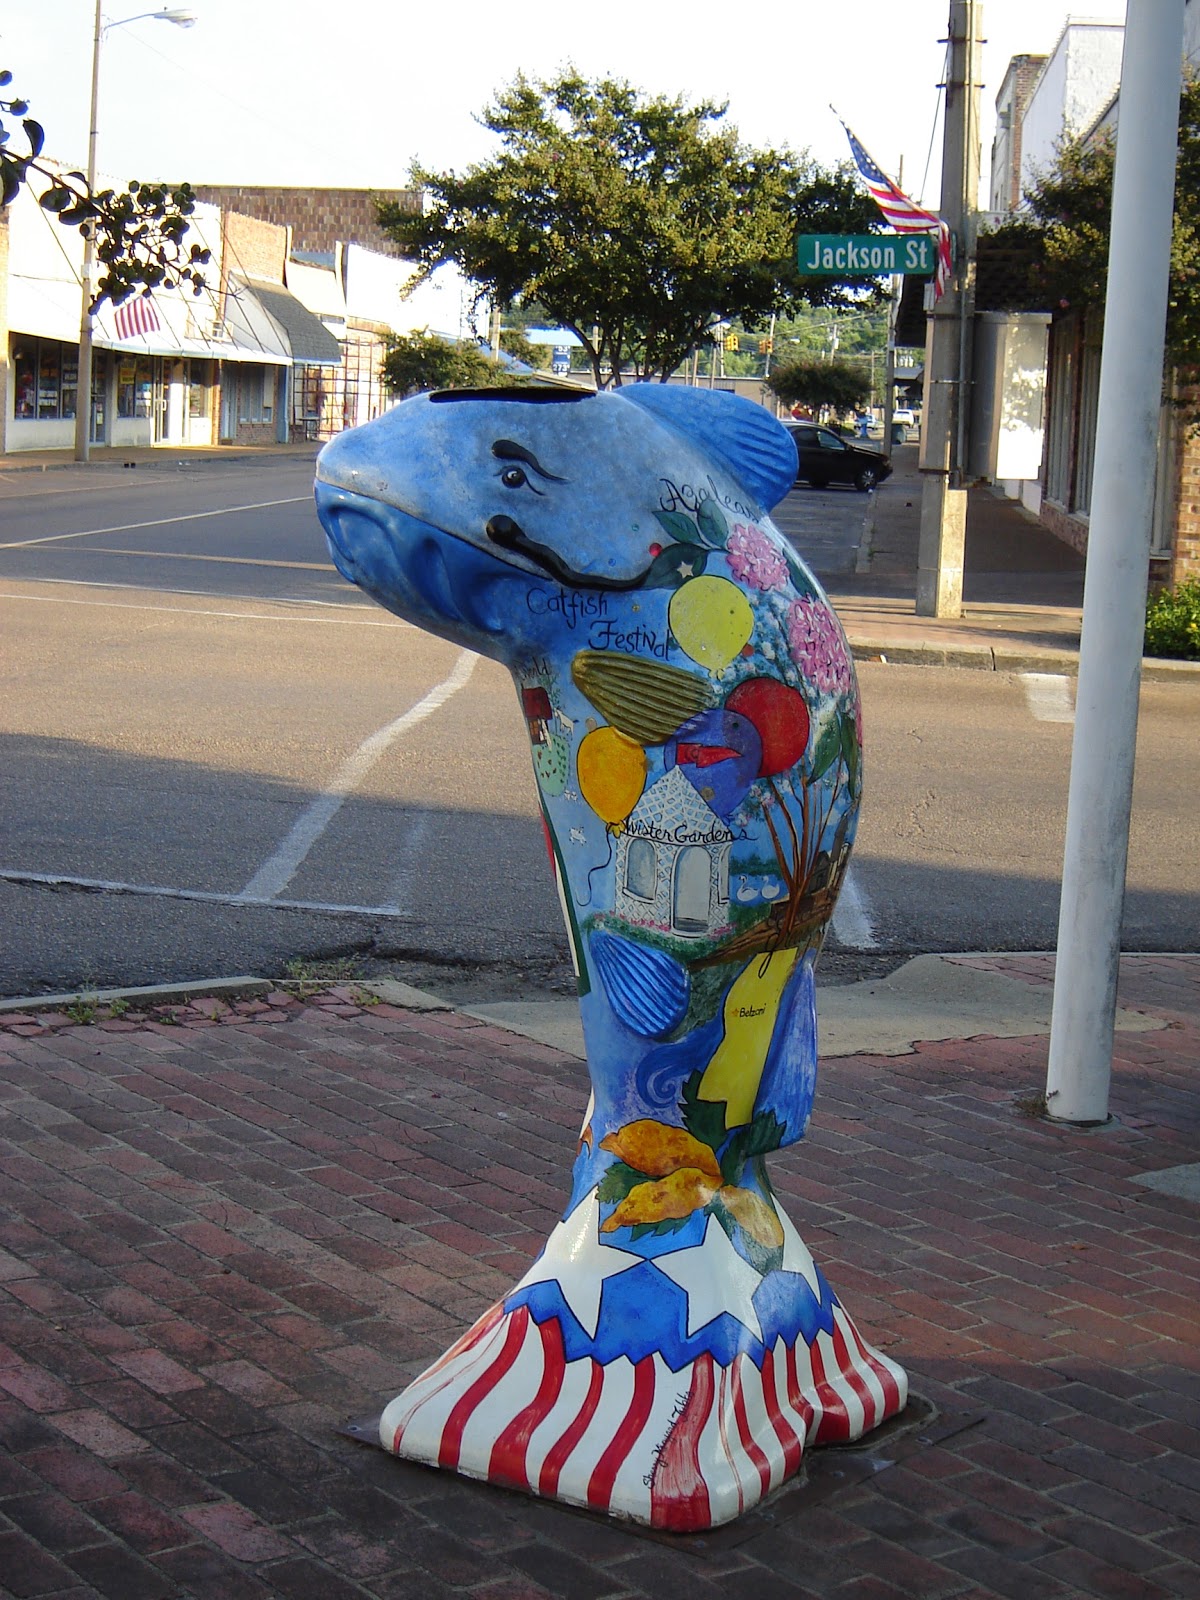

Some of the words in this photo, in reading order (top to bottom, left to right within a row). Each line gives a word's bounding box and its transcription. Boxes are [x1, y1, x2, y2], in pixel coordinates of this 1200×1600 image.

[807, 241, 895, 270] Jackson
[905, 240, 928, 270] St
[526, 587, 608, 630] Catfish
[588, 619, 670, 662] Festival
[674, 820, 759, 843] Gardens
